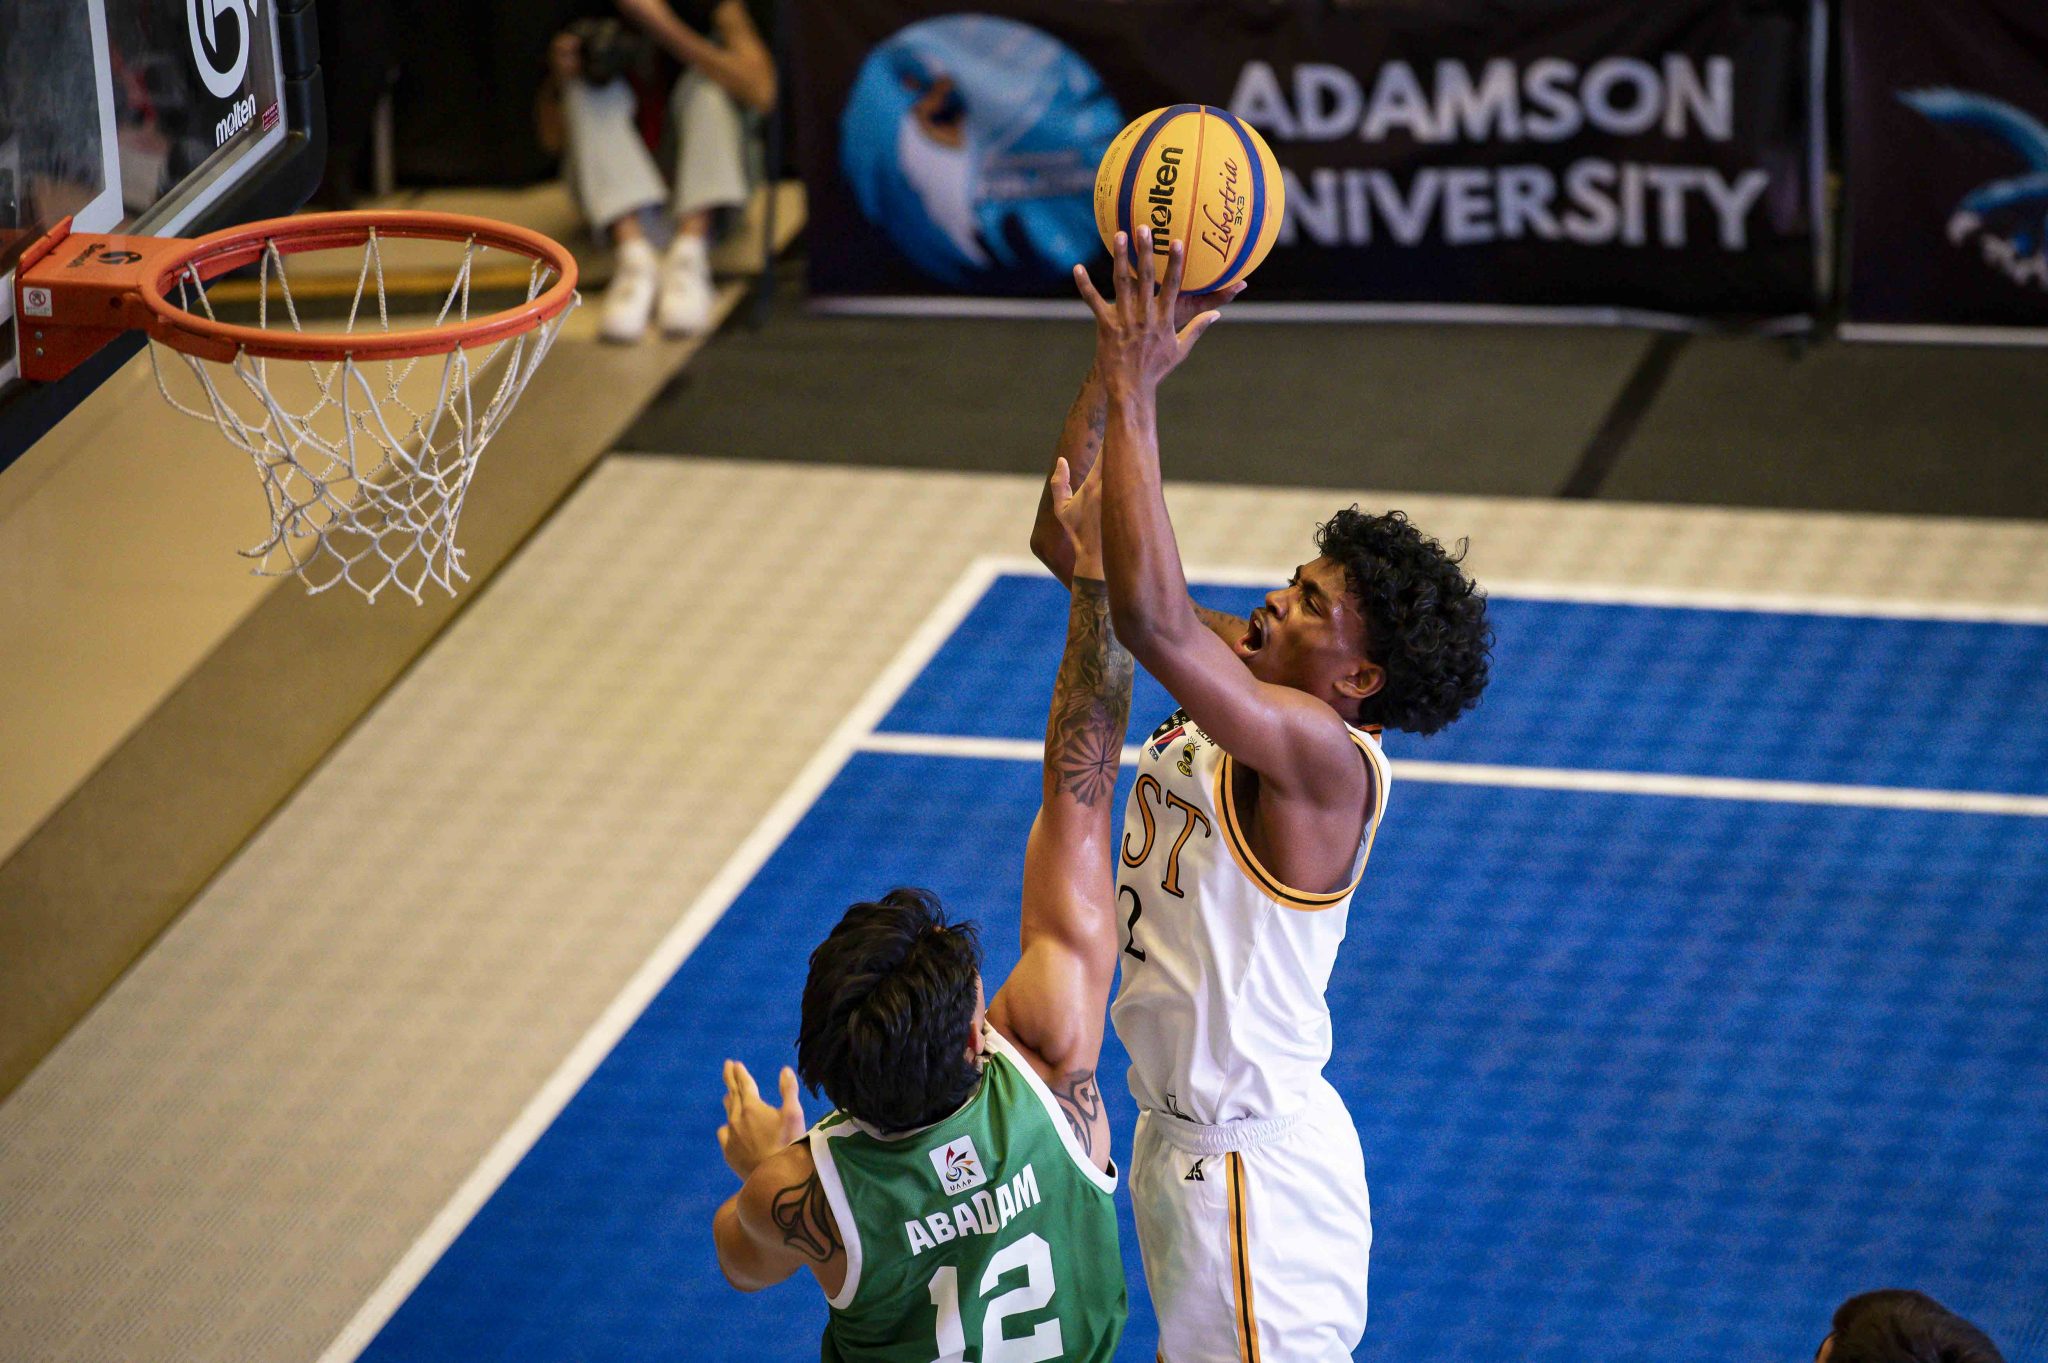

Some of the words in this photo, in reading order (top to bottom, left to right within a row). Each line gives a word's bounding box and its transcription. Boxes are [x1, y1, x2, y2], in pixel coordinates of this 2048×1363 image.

[215, 93, 256, 148] molten
[1231, 54, 1735, 144] ADAMSON
[1148, 145, 1184, 256] molten
[1201, 157, 1238, 263] Libertria
[1277, 157, 1770, 251] NIVERSITY
[904, 1163, 1041, 1257] ABADAM
[949, 1178, 973, 1191] UAAP
[927, 1231, 1064, 1363] 12
